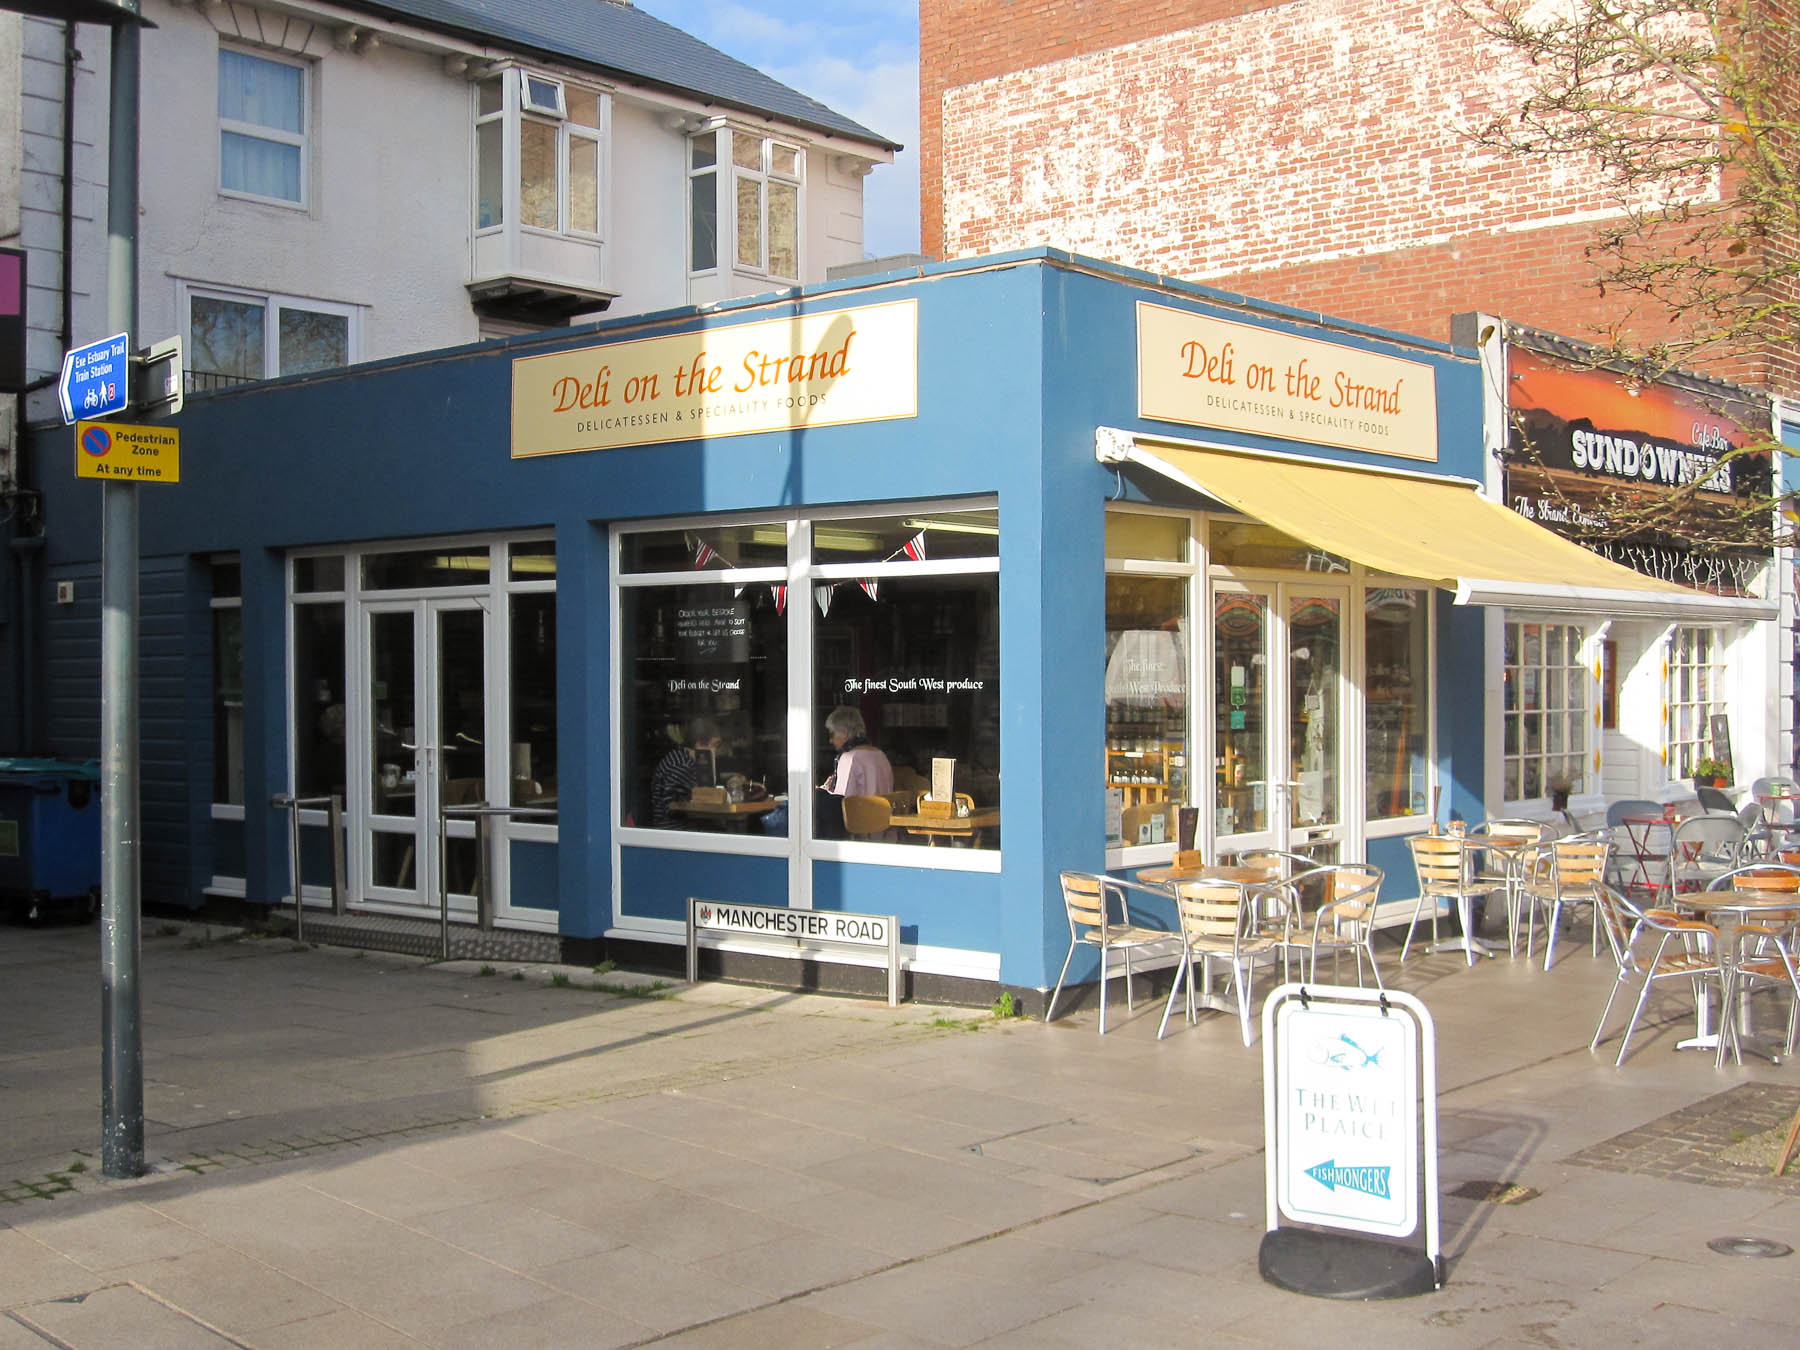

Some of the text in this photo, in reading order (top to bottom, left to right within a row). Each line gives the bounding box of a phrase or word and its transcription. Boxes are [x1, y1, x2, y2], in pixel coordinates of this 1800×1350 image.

[75, 341, 125, 368] Exe Estuary Trail
[75, 363, 113, 384] Train Station
[552, 331, 856, 413] Deli on the Strand
[1180, 340, 1404, 415] Deli on the Strand
[577, 392, 828, 433] DELICATESSEN & SPECIALITY FOODS
[1207, 394, 1390, 436] DELICATESSEN & SPECIALITY FOODS
[116, 431, 176, 445] Pedestrian
[132, 445, 160, 456] Zone
[96, 463, 162, 477] At any time
[1572, 429, 1732, 494] SUNDOWNERS
[1514, 495, 1535, 519] The
[1537, 499, 1569, 523] Strand
[667, 678, 741, 693] Deli on the Strand
[844, 678, 984, 694] The finest South West produce
[717, 908, 884, 941] MANCHESTER ROAD
[1295, 1087, 1342, 1111] THE
[1312, 1166, 1387, 1197] FISHMONGERS
